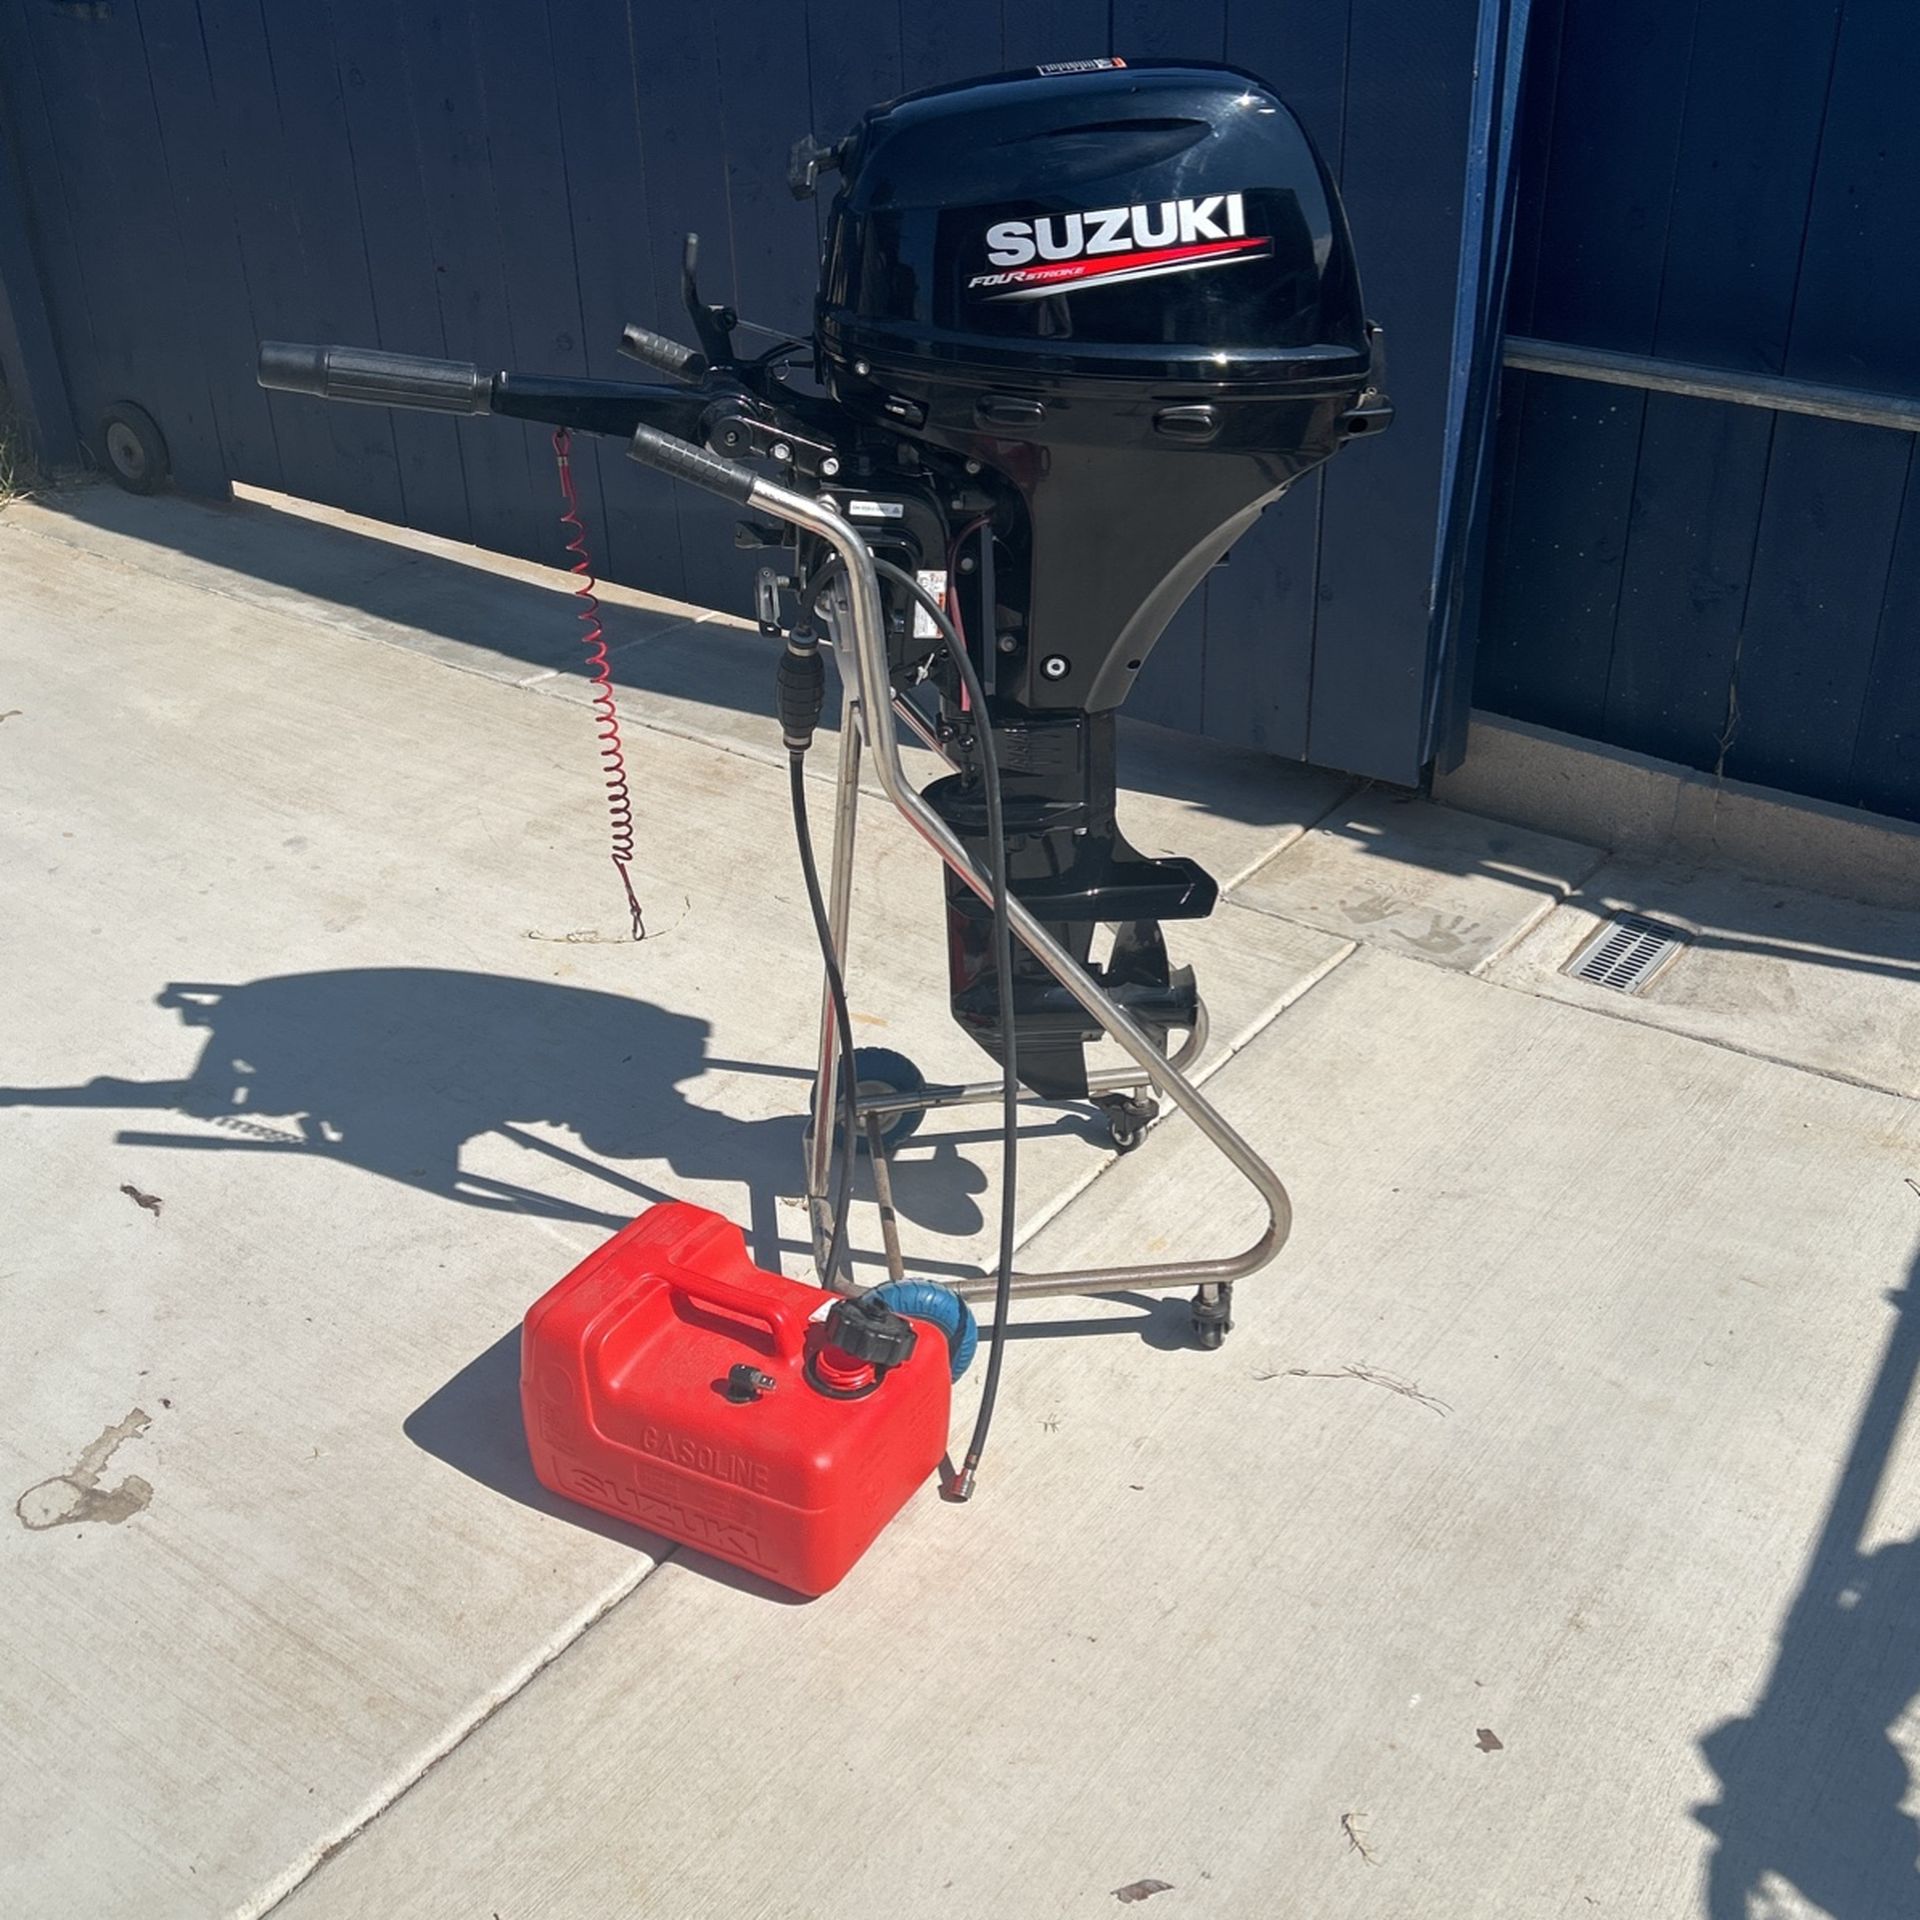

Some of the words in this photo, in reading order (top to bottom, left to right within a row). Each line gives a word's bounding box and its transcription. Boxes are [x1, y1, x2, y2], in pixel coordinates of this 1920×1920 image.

[986, 193, 1245, 267] SUZUKI
[643, 1426, 769, 1493] GASOLINE
[569, 1467, 763, 1561] SUZUKI
